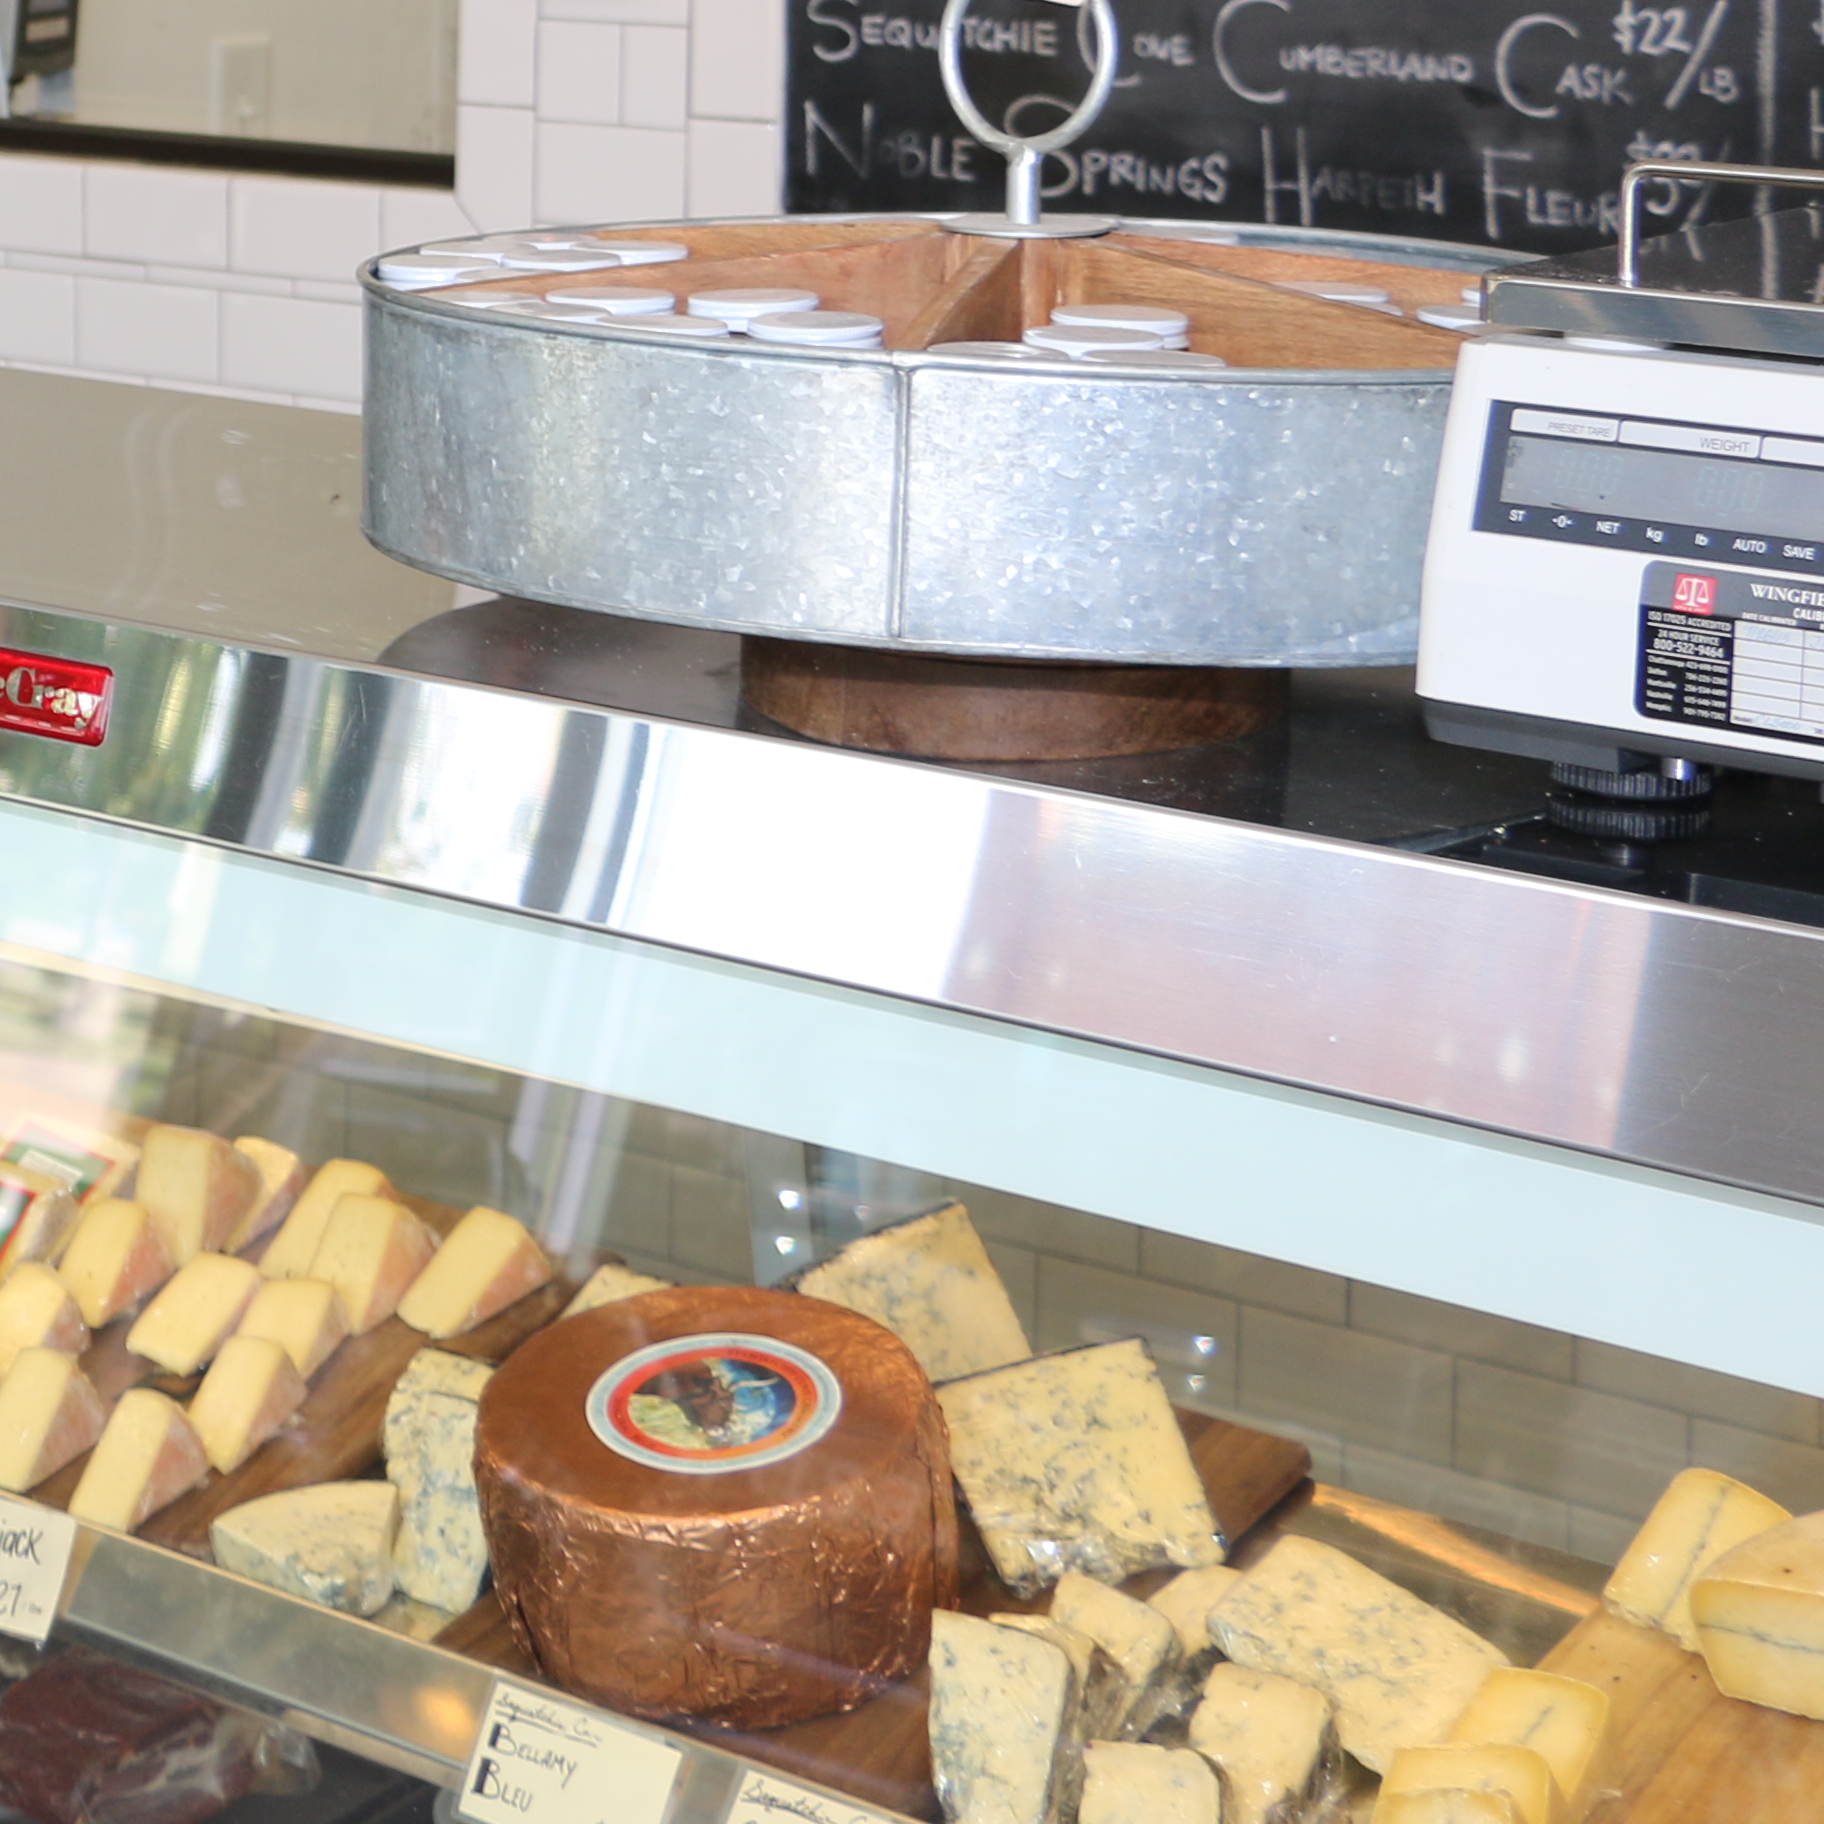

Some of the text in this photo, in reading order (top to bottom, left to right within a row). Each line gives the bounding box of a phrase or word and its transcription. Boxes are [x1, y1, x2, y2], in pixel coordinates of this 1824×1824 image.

[1495, 14, 1633, 118] CASK
[1548, 421, 1611, 438] PRESET TARE
[1699, 435, 1751, 454] WEIGHT
[1508, 509, 1526, 523] ST
[1595, 520, 1620, 535] NET
[1645, 526, 1664, 544] kg
[1694, 532, 1709, 547] lb
[1732, 537, 1767, 554] AUTO
[1782, 544, 1816, 561] SAVE
[487, 1722, 578, 1790] BELLAMY
[471, 1756, 534, 1813] BLEU
